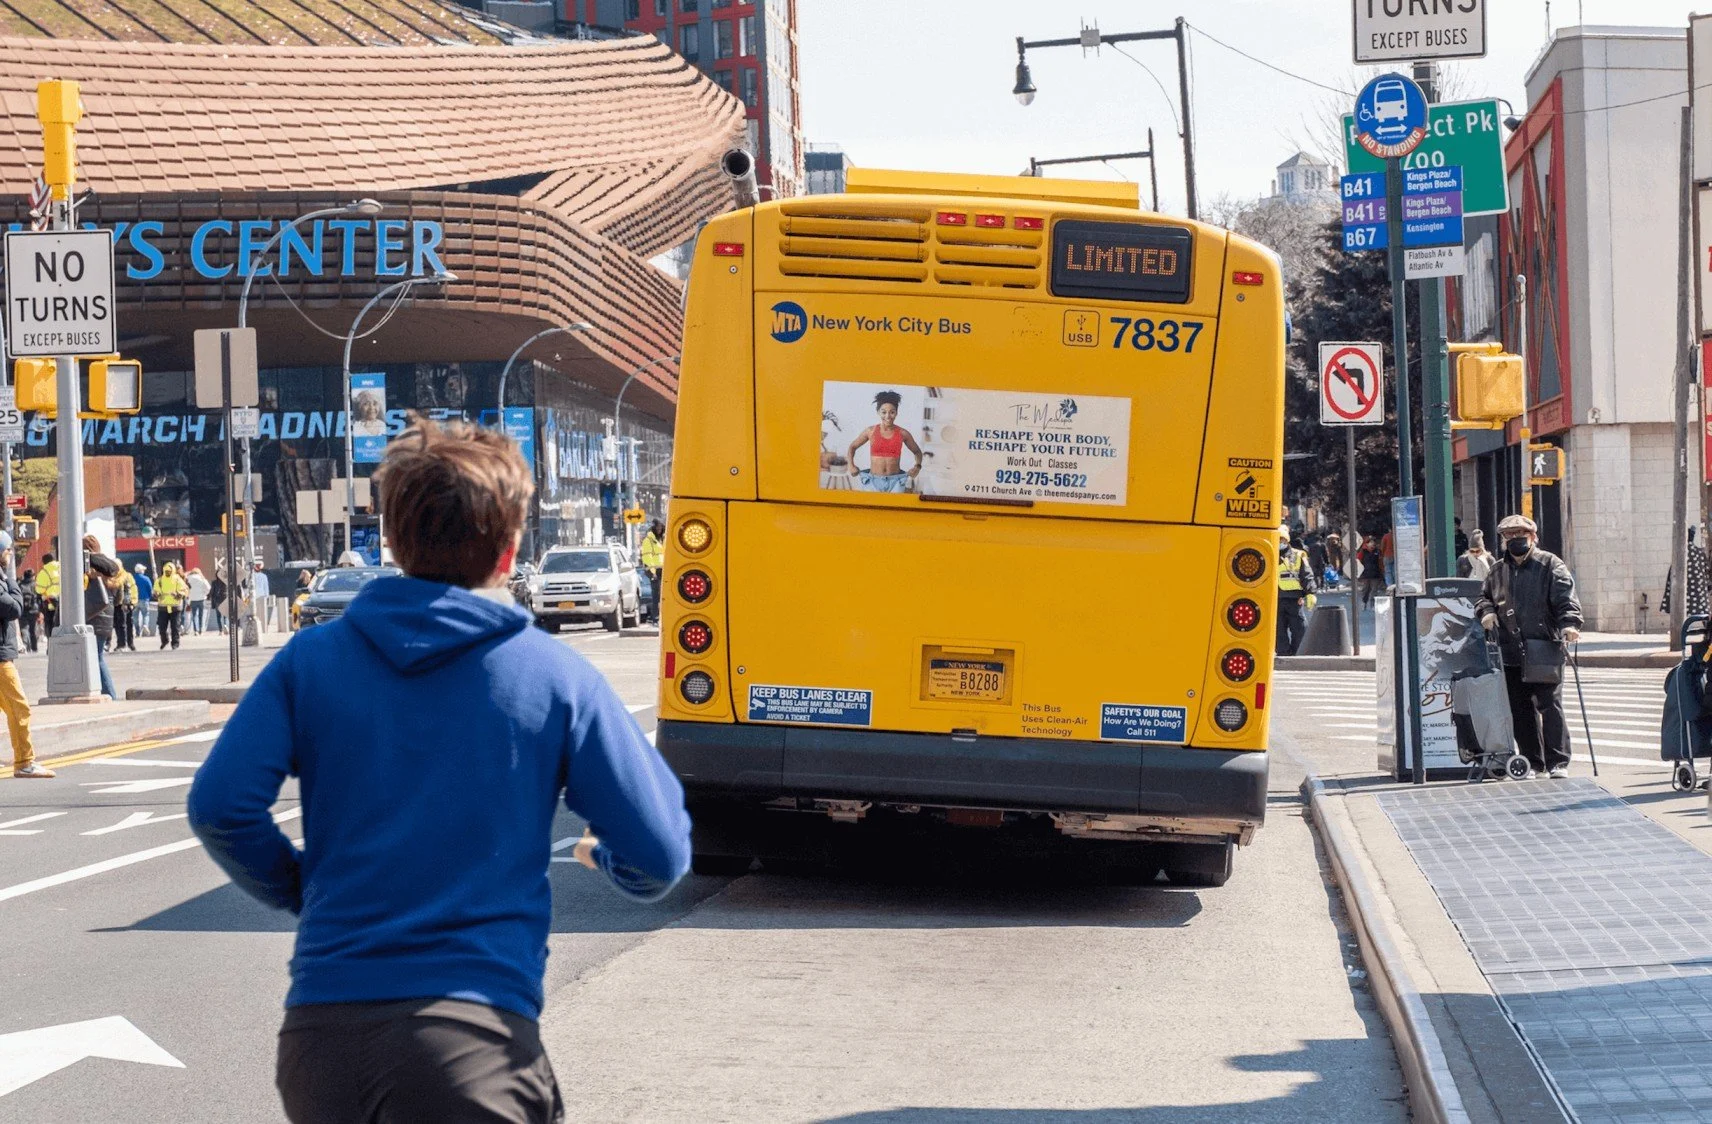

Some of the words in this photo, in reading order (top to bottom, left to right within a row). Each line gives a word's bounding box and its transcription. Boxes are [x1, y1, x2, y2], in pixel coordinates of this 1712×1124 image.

[1372, 32, 1419, 49] EXCEPT
[1427, 28, 1468, 46] BUSES
[1466, 109, 1494, 134] Pk
[1362, 134, 1376, 149] NO
[1376, 129, 1421, 156] STANDING
[1407, 171, 1427, 182] Kings
[1429, 169, 1452, 180] Plaza/
[1344, 178, 1372, 197] B41
[1407, 180, 1433, 191] Bergen
[1434, 178, 1457, 188] Beach
[1406, 199, 1425, 209] Kings
[1426, 196, 1447, 206] Plaza/
[1346, 203, 1374, 222] B41
[1406, 207, 1430, 218] Bergen
[1431, 205, 1452, 215] Beach
[1406, 222, 1444, 233] Kensington
[1346, 228, 1377, 247] B67
[190, 219, 446, 279] CENTER
[1408, 250, 1436, 260] Flatbush
[1437, 250, 1447, 258] Av
[1449, 249, 1454, 257] &
[35, 251, 85, 282] NO
[1066, 244, 1177, 277] LIMITED
[1408, 262, 1434, 271] Atlantic
[1435, 261, 1444, 270] Av
[15, 295, 107, 322] TURNS
[770, 311, 801, 333] MTA
[812, 314, 851, 331] New
[855, 315, 893, 332] York
[898, 317, 932, 335] City
[939, 318, 972, 334] Bus
[24, 333, 64, 347] EXCEPT
[67, 331, 101, 345] BUSES
[1068, 333, 1093, 343] USB
[1110, 316, 1204, 353] 7837
[0, 410, 18, 425] 25
[1010, 404, 1029, 426] The
[82, 415, 206, 445] MARCH
[219, 409, 407, 441] ADNES
[975, 428, 1034, 441] RESHAPE
[1037, 432, 1072, 443] YOUR
[1075, 434, 1112, 447] BODY,
[968, 440, 1027, 453] RESHAPE
[1031, 443, 1066, 455] YOUR
[1069, 446, 1118, 458] FUTURE
[1007, 456, 1027, 467] Work
[1028, 457, 1042, 468] Out
[1048, 458, 1078, 470] Classes
[1231, 458, 1271, 468] CAUTION
[995, 469, 1087, 488] 929-275-5622
[971, 485, 989, 494] 4711
[991, 486, 1017, 496] Church
[1018, 487, 1032, 496] Ave
[1044, 489, 1117, 501] theemedspanyc.com
[1229, 500, 1269, 512] WIDE
[152, 538, 194, 547] KICKS
[752, 687, 777, 698] KEEP
[779, 689, 799, 699] BUS
[801, 690, 833, 701] LANES
[835, 691, 867, 703] CLEAR
[1433, 683, 1451, 692] STO
[767, 705, 808, 713] ENFORCEMENT
[1023, 704, 1041, 712] This
[1044, 705, 1061, 713] Bus
[1105, 707, 1141, 717] SAFETY'S
[1143, 709, 1160, 718] OUR
[1162, 710, 1183, 718] GOAL
[1022, 715, 1043, 723] Uses
[1047, 717, 1087, 725] Clean-Air
[1104, 717, 1122, 725] How
[1154, 720, 1182, 729] Doing?
[1022, 726, 1073, 736] Technology
[1127, 727, 1142, 736] Call
[1144, 728, 1156, 737] 511
